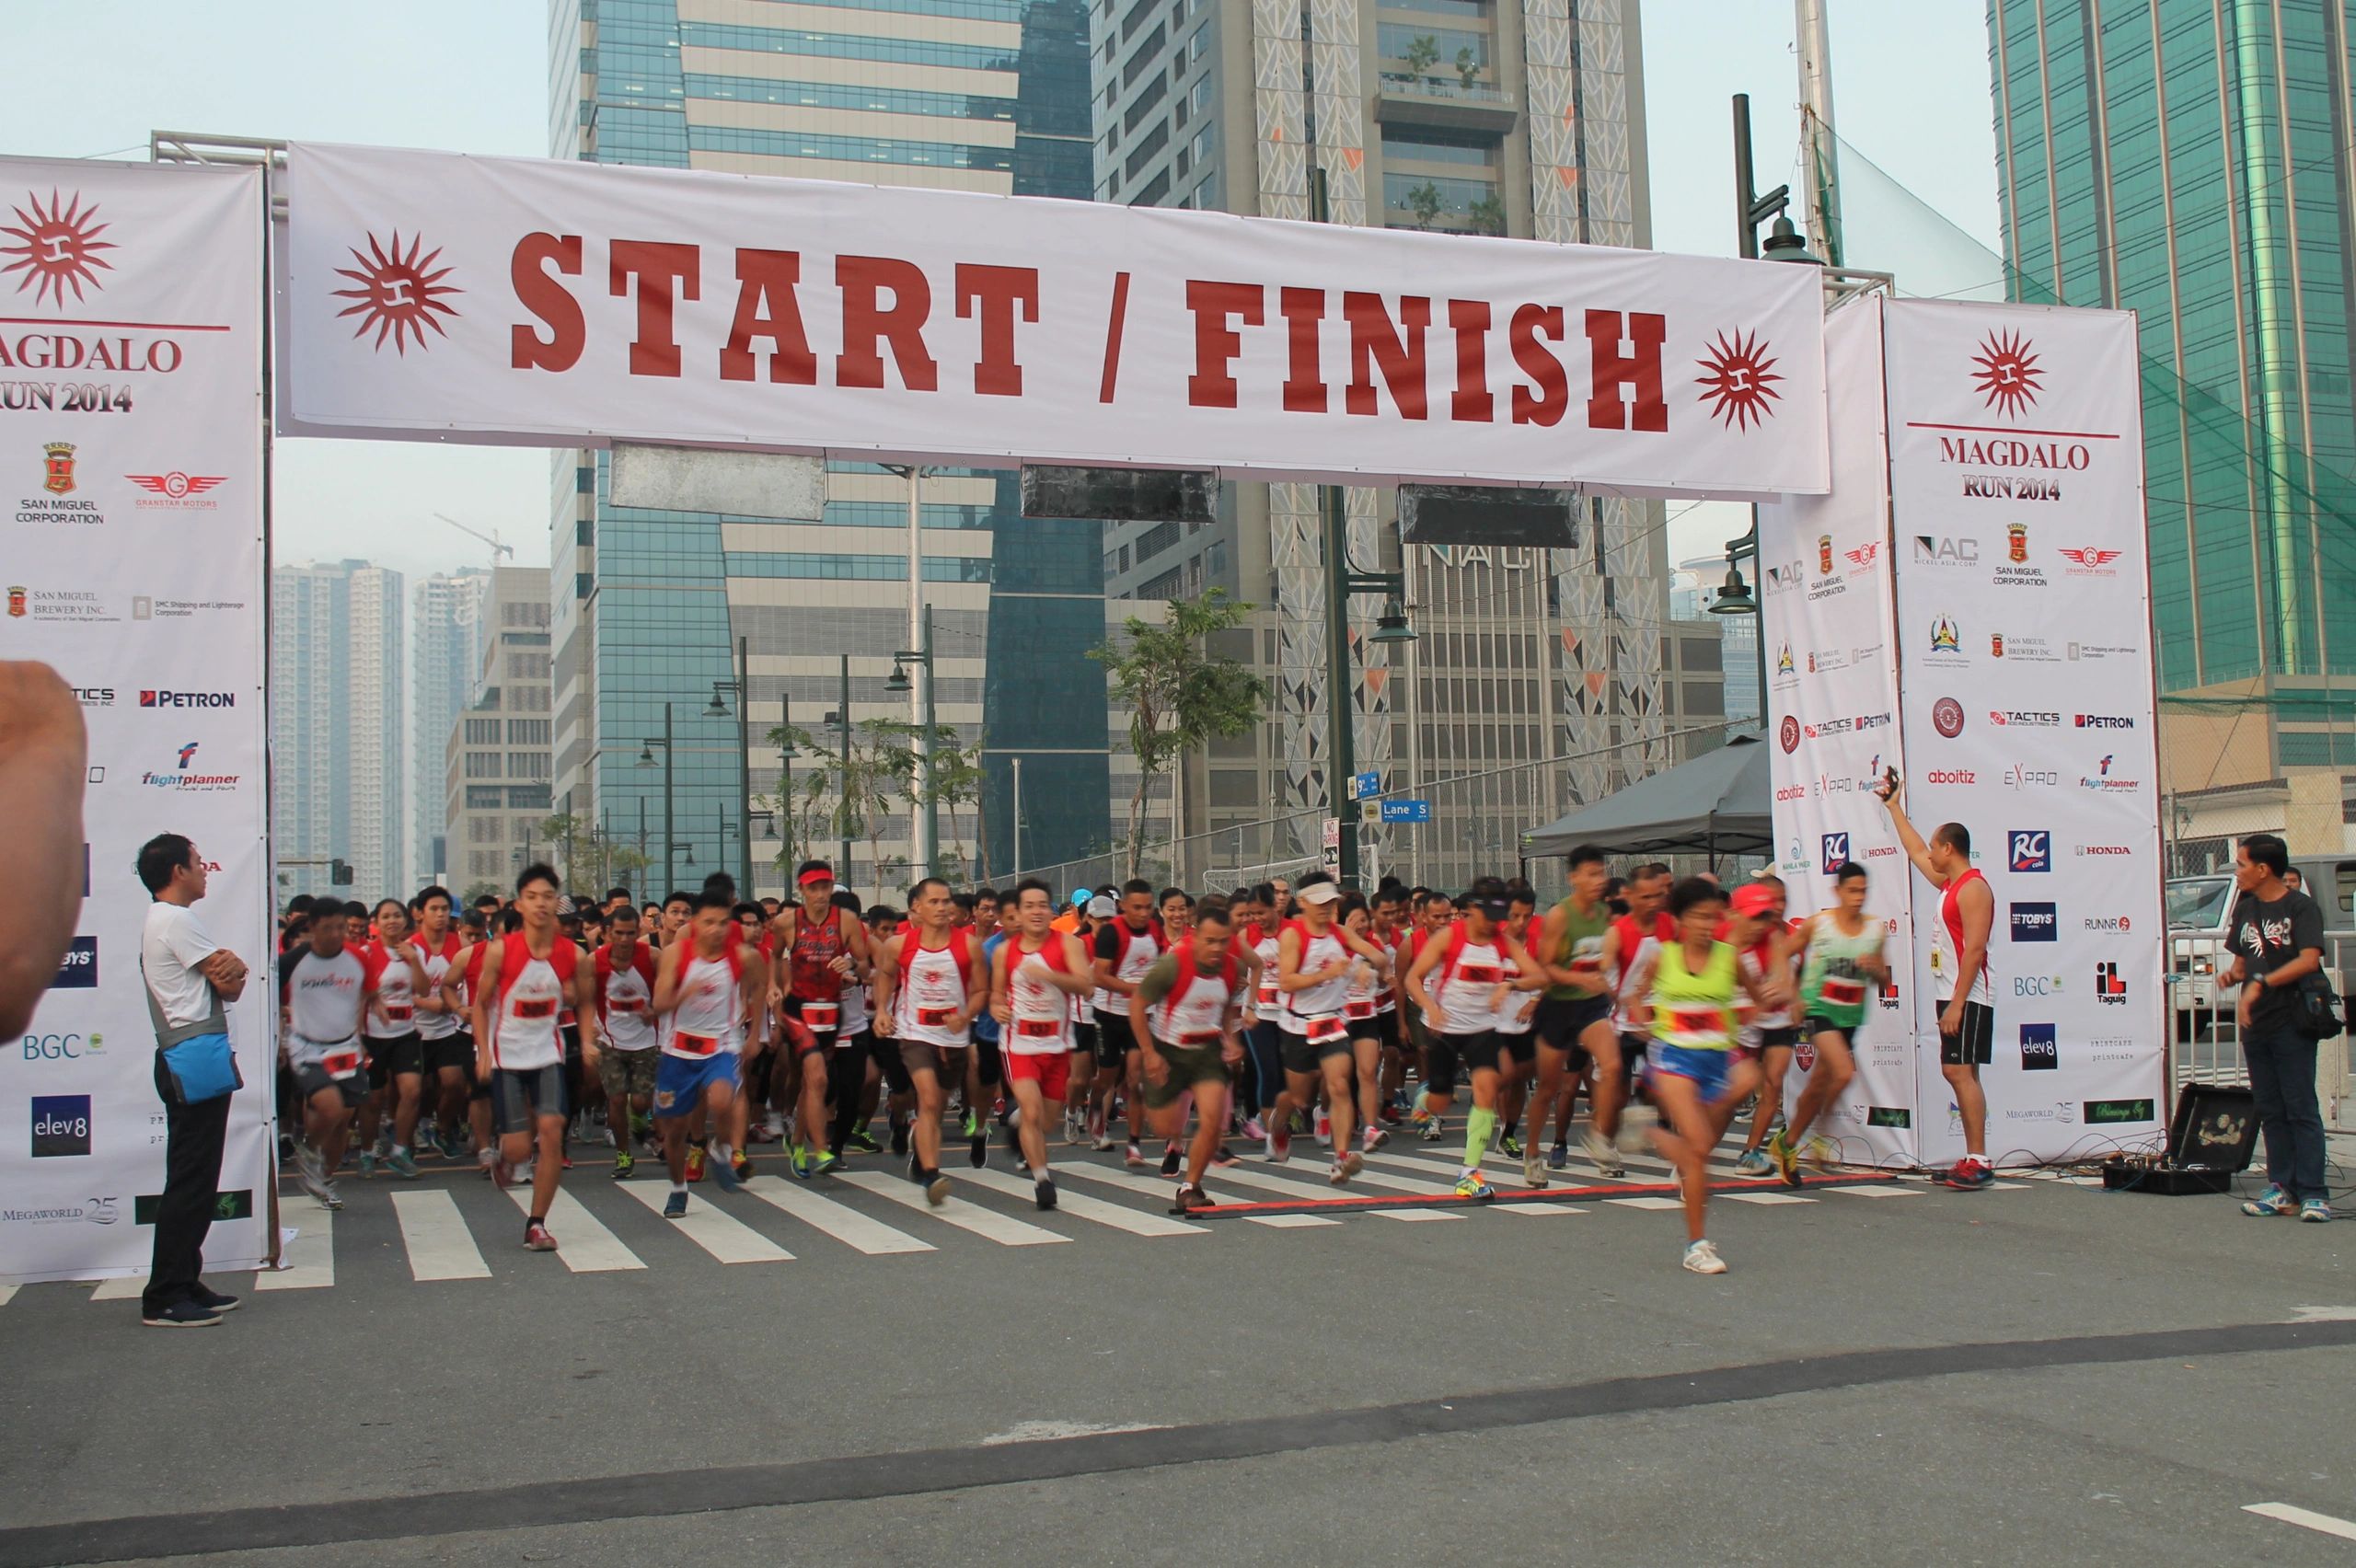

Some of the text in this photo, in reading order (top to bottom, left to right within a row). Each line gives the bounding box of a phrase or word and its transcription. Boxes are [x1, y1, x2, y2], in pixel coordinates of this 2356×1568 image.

[511, 231, 1669, 432] START / FINISH
[0, 334, 182, 373] AGDALO
[0, 381, 133, 413] UN 2014
[1939, 436, 2090, 470] MAGDALO
[1962, 474, 2061, 502] RUN 2014
[21, 499, 98, 511] SAN MIGUEL
[135, 499, 218, 508] GRANSTAR MOTORS
[16, 513, 104, 525] CORPORATION
[1914, 535, 1979, 560] NAC
[1422, 544, 1530, 570] NAC
[1995, 566, 2042, 576] SAN MIGUEL
[1811, 580, 1823, 591] SAN
[1823, 575, 1842, 588] MIGUEL
[1993, 577, 2047, 586] CORPORATION
[34, 590, 97, 601] SAN MIGUEL
[1807, 584, 1846, 601] CORPORATION
[34, 604, 84, 615] BREWERY
[170, 601, 198, 610] Shipping
[199, 601, 211, 609] and
[2022, 637, 2047, 645] MIGUEL
[2008, 647, 2038, 656] BREWERY
[71, 688, 114, 700] TICS
[158, 690, 235, 708] PETRON
[1864, 712, 1890, 730] PETRN
[2006, 711, 2061, 722] TACTICS
[2086, 715, 2134, 729] PETRON
[1817, 718, 1853, 732] TACTICS
[143, 771, 240, 787] flightplanner
[1928, 769, 1975, 784] aboitiz
[2080, 776, 2140, 789] flightplanner
[1383, 804, 1426, 814] Lane S
[1326, 821, 1334, 833] NO
[1825, 834, 1847, 868] RC
[1868, 847, 1898, 859] HONDA
[2012, 832, 2046, 865] RC
[2086, 847, 2131, 855] HONDA
[2032, 860, 2044, 869] cola
[2021, 913, 2053, 925] TOBYS
[2085, 918, 2118, 930] RUNNR
[61, 951, 91, 965] BYS
[2014, 976, 2050, 997] BGC
[1879, 998, 1899, 1010] Taguig
[2097, 994, 2127, 1006] Taguig
[24, 1033, 81, 1060] BGC
[2005, 1109, 2053, 1119] MEGAWORLD
[3, 1208, 83, 1221] MEGAWORLD
